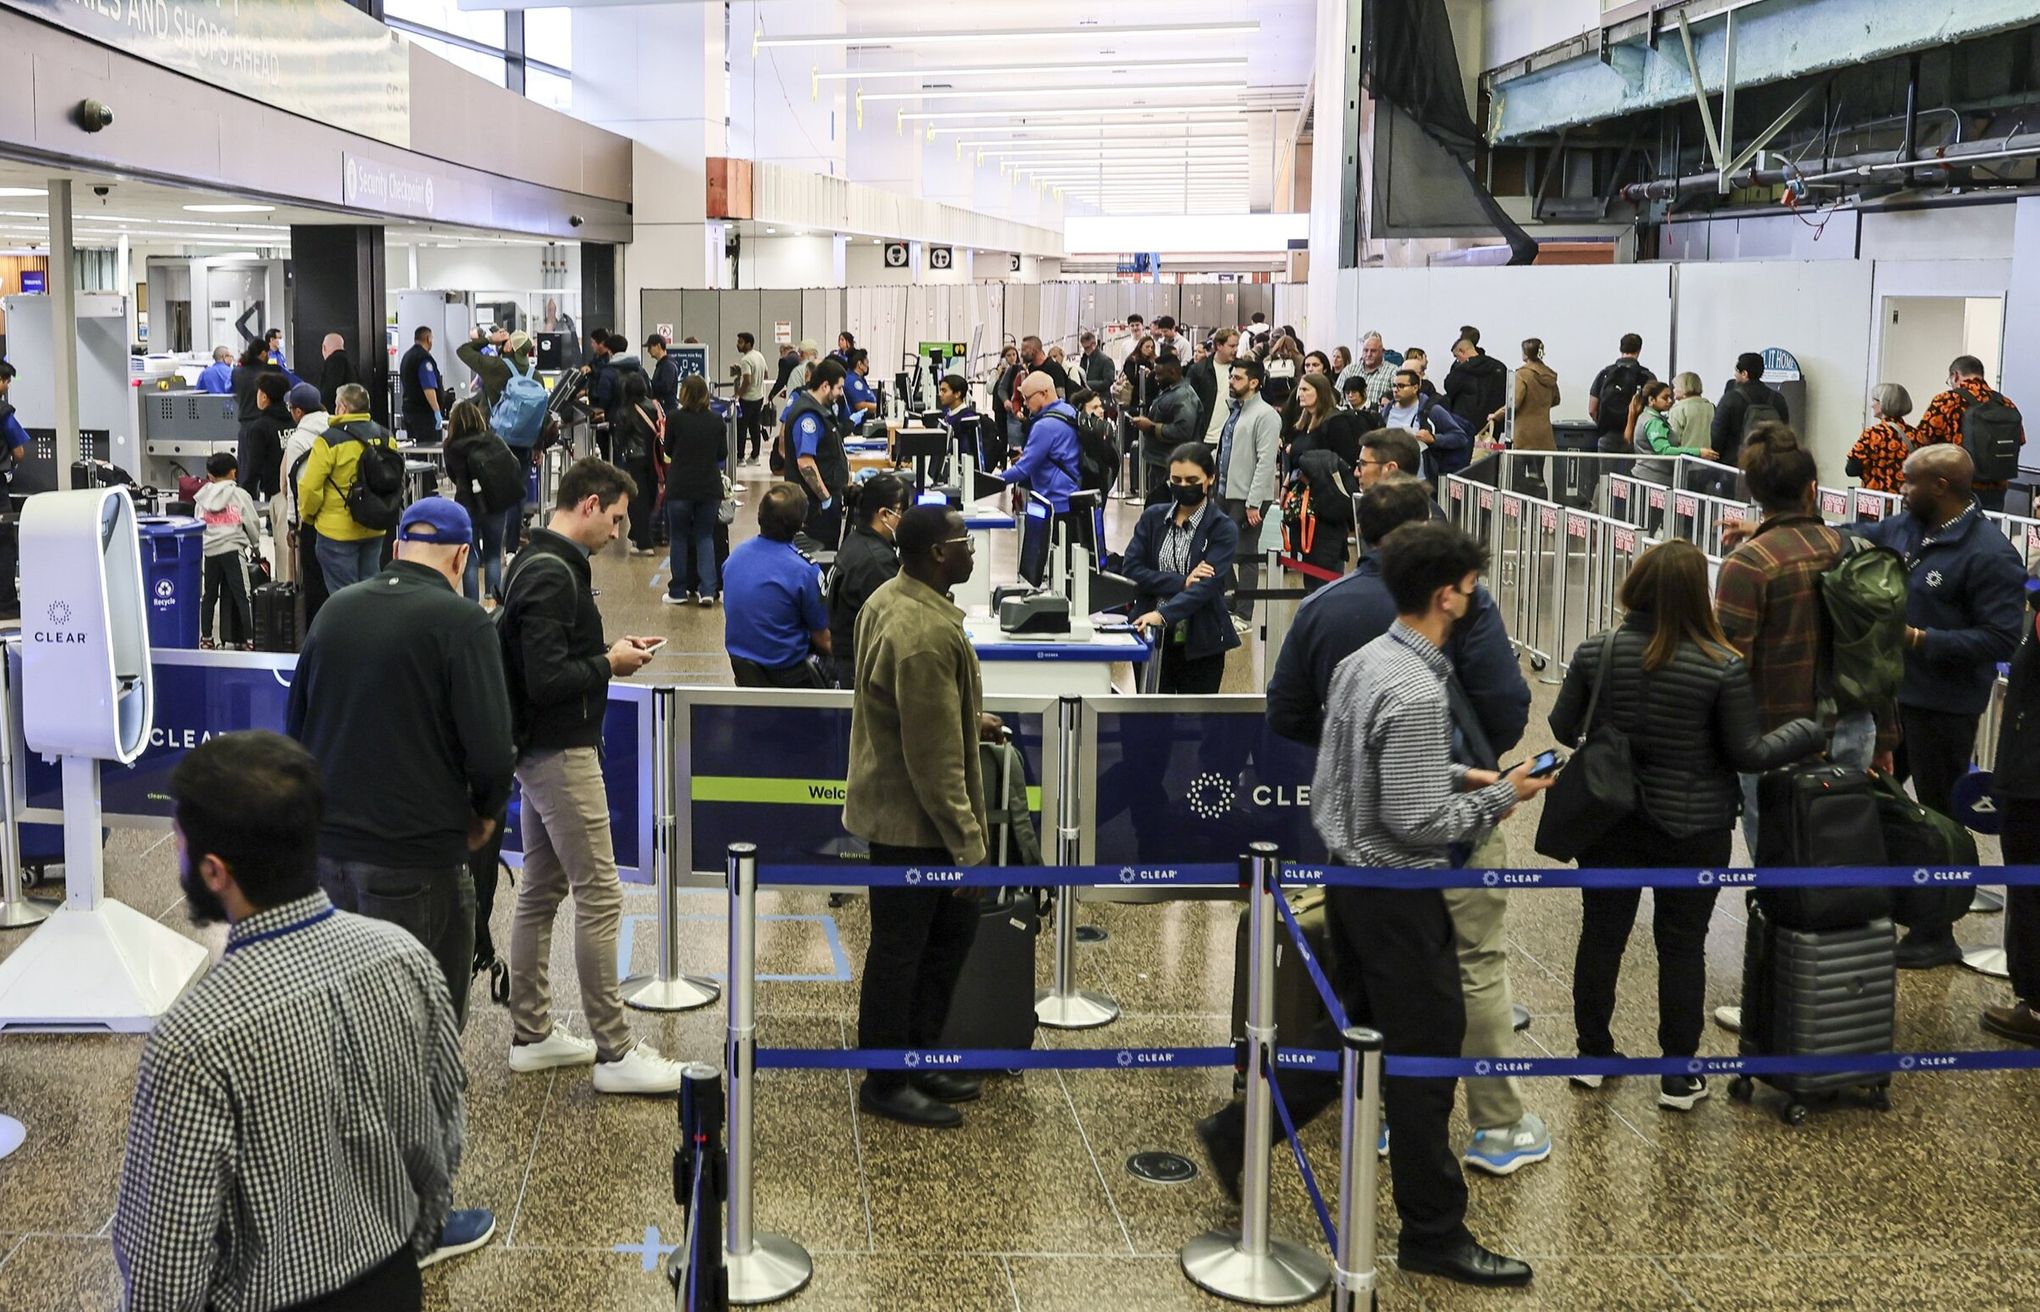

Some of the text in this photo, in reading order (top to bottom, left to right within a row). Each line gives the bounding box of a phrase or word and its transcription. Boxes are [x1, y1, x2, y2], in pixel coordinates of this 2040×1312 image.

[128, 0, 168, 39] AND
[174, 6, 229, 66] SHOPS
[233, 44, 279, 86] AHEAD
[358, 166, 387, 204] Security
[389, 172, 424, 208] Checkpoint
[153, 597, 176, 606] Recycle
[34, 631, 86, 644] CLEAR
[149, 727, 227, 748] CLEA
[808, 785, 846, 799] Welc
[1252, 785, 1311, 806] CLE
[926, 872, 962, 881] CLEAR
[1140, 870, 1175, 879] CLEAR
[1284, 869, 1321, 879] CLEAR
[1503, 874, 1540, 882] CLEAR
[1718, 873, 1754, 882] CLEAR
[1933, 871, 1970, 880] CLEAR
[925, 1054, 960, 1063] CLEAR
[1137, 1053, 1172, 1062] CLEAR
[1277, 1053, 1313, 1063] CLEAR
[1920, 1056, 1955, 1065] CLEAR
[1495, 1062, 1530, 1071] CLEAR
[1707, 1061, 1744, 1069] CLEAR
